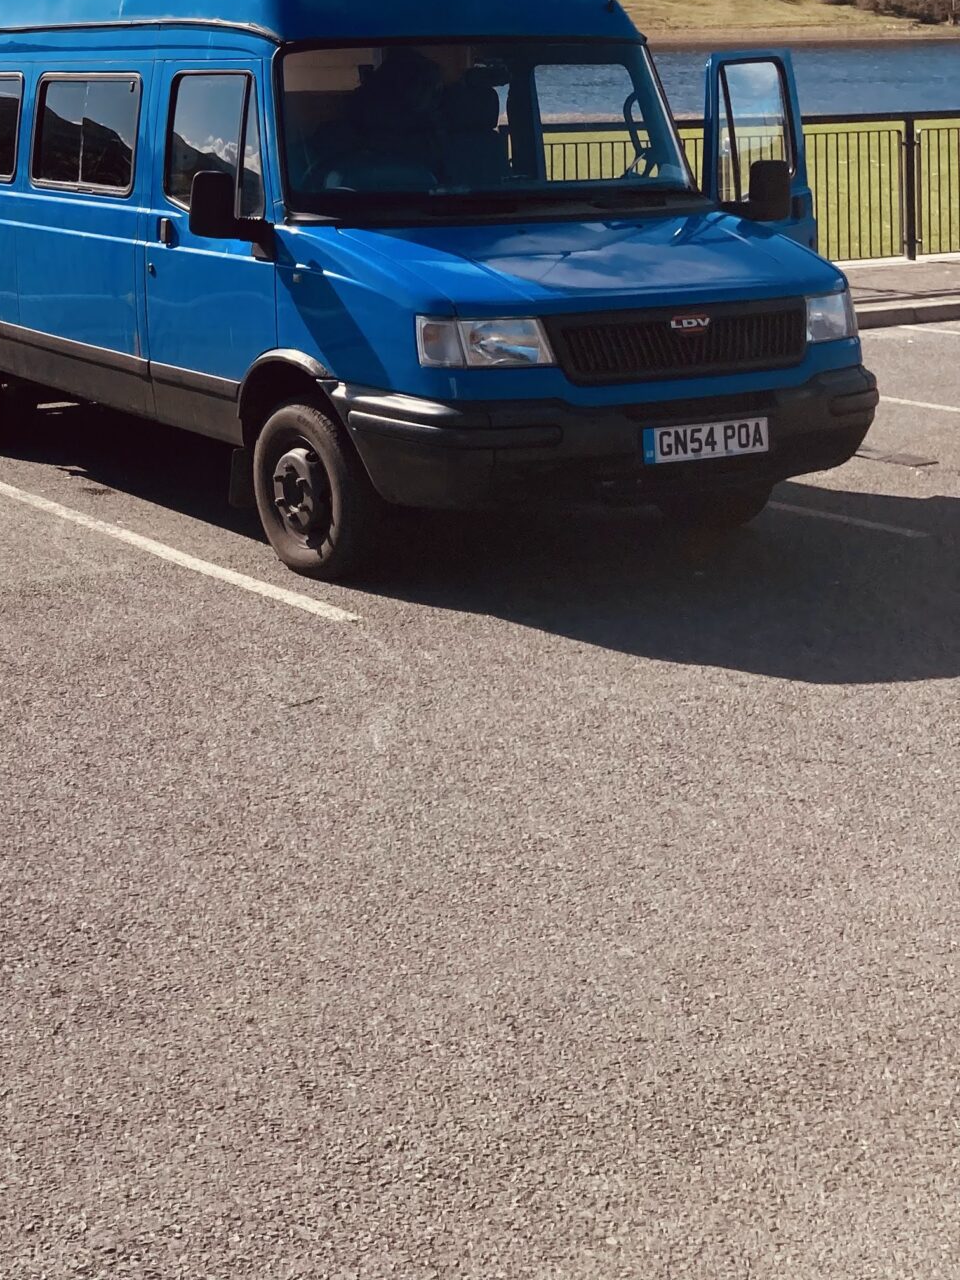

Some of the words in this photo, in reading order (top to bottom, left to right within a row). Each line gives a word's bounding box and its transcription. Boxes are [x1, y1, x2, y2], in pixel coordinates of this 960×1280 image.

[670, 318, 710, 329] LDV
[659, 426, 717, 456] GN54
[723, 422, 764, 451] POA
